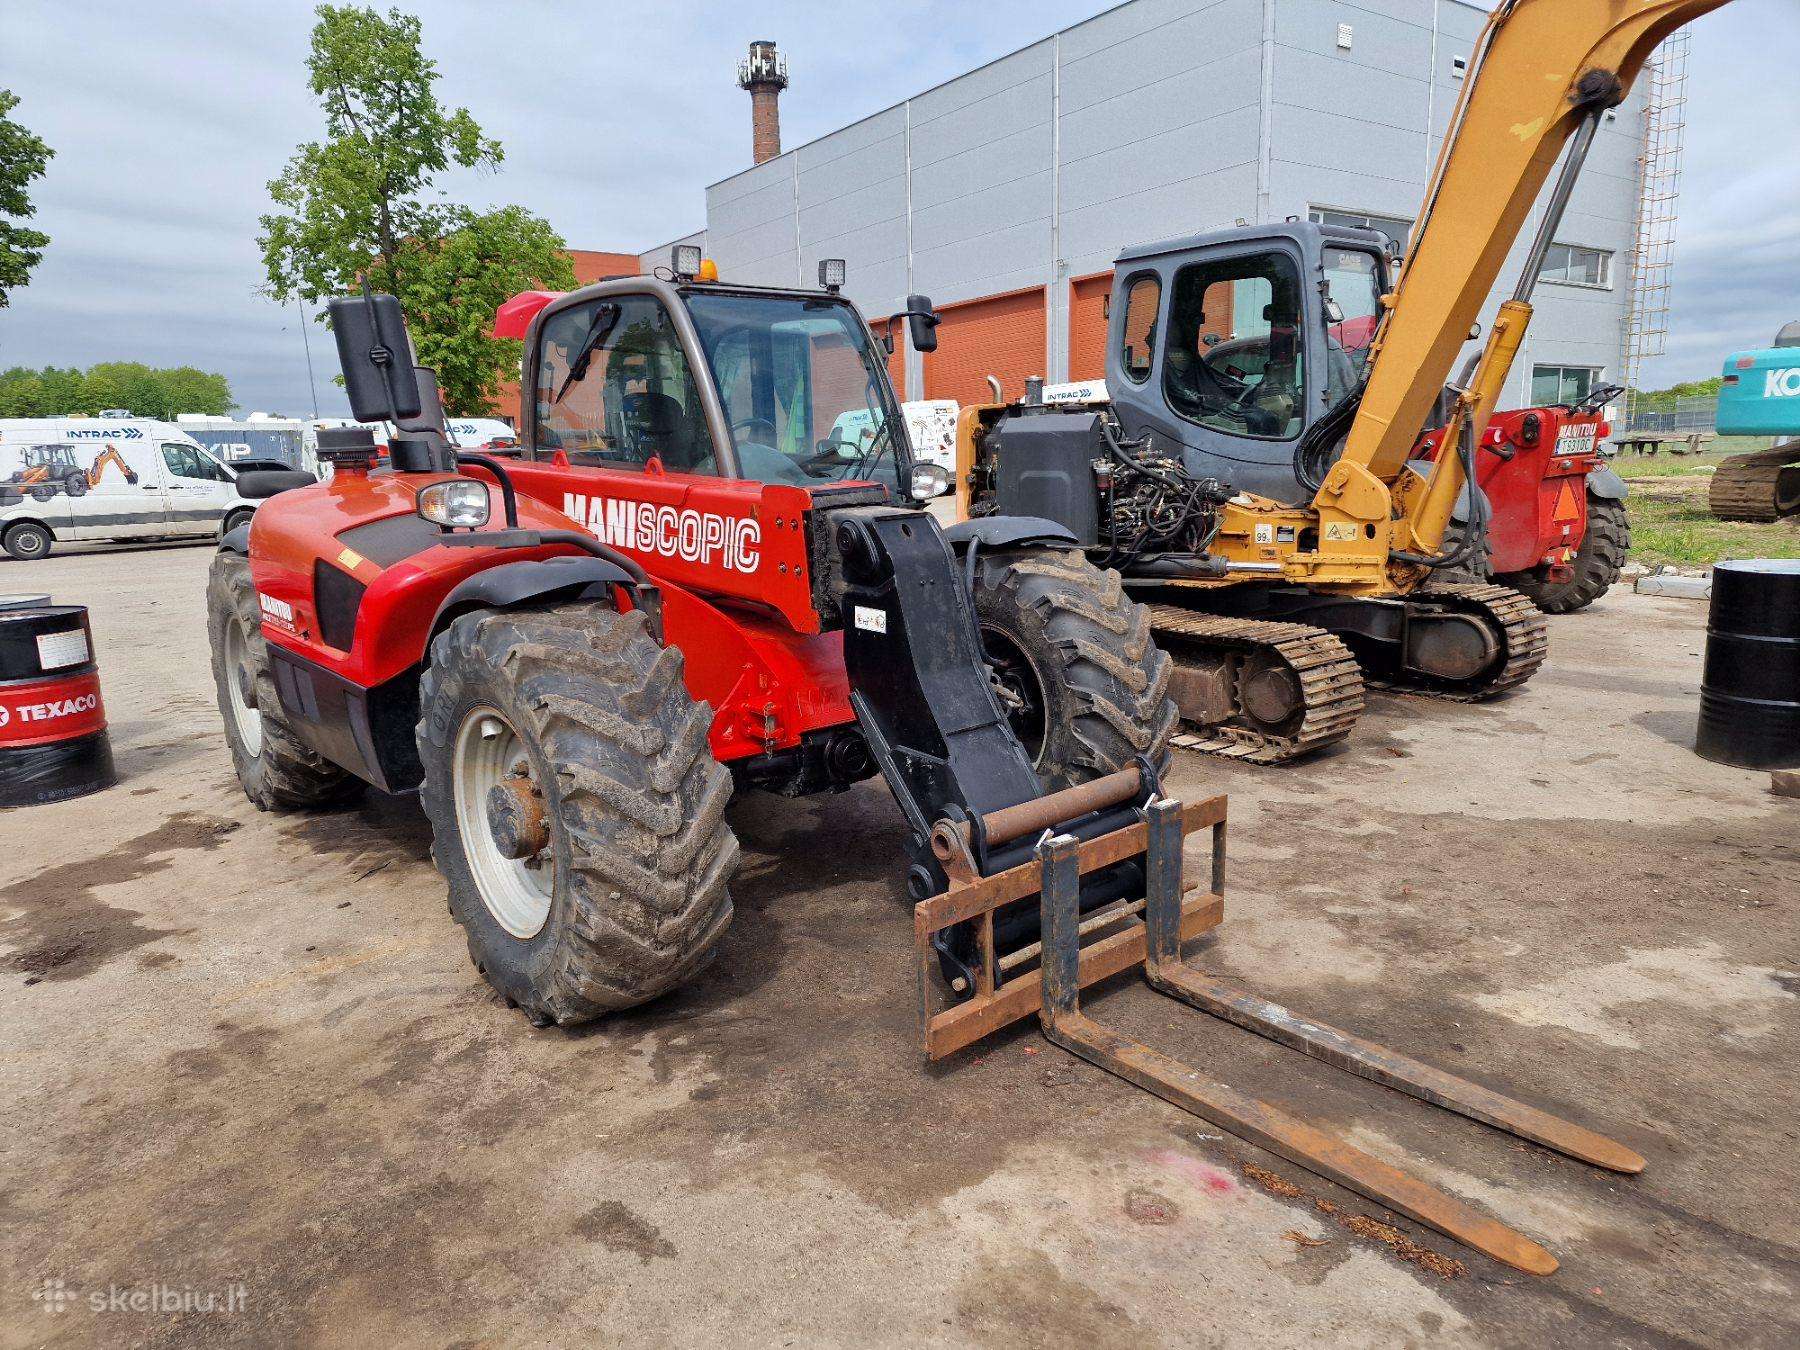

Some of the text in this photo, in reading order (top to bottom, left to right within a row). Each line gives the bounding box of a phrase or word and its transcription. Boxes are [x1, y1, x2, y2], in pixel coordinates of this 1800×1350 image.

[1048, 391, 1079, 400] INTRAC
[66, 430, 121, 438] INTRAC
[1558, 422, 1597, 438] MANITOU
[563, 492, 761, 574] MANISCOPIC
[16, 694, 96, 722] TEXACO
